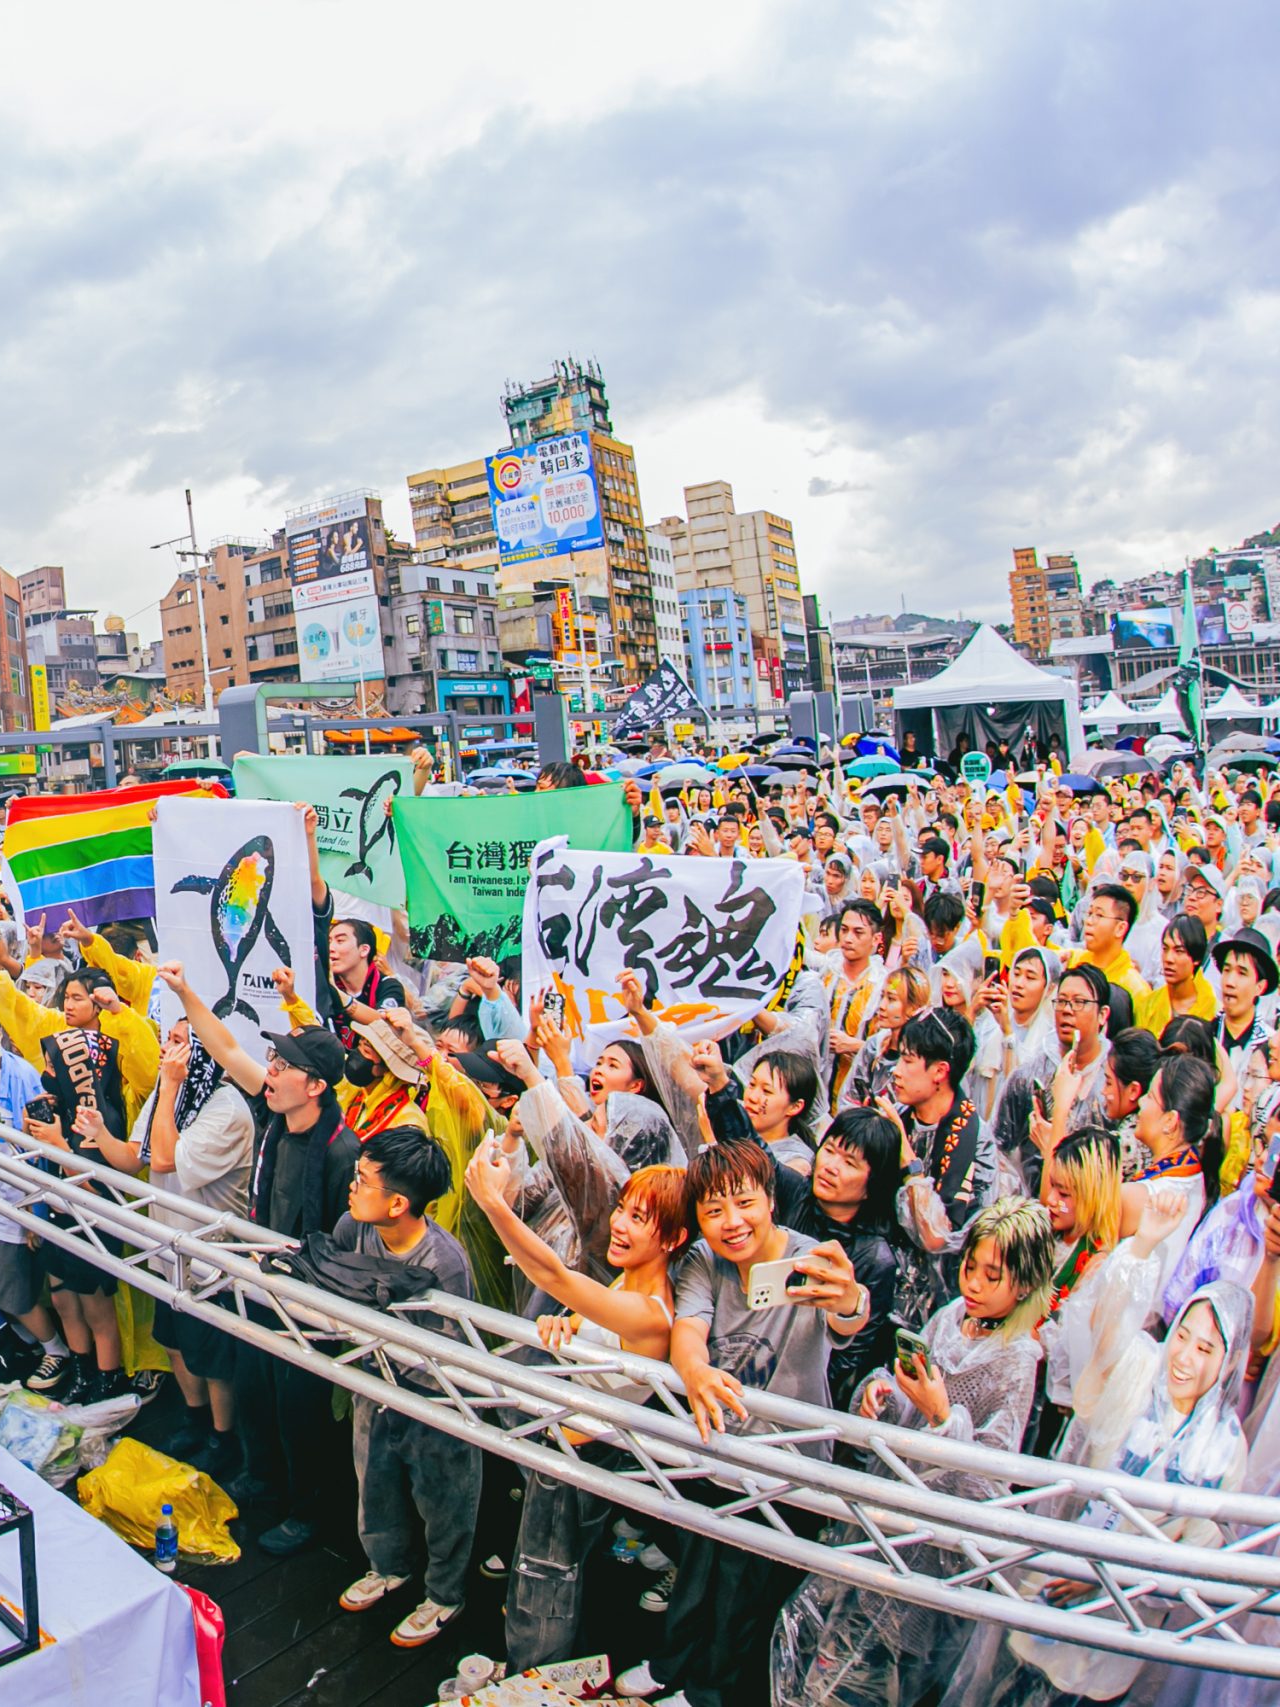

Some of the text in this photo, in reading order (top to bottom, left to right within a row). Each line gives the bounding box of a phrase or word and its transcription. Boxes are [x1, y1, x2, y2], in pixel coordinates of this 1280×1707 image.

[538, 437, 582, 458] 電動機車
[540, 452, 585, 476] 騎回家
[317, 834, 350, 846] stand for
[449, 874, 452, 883] I
[453, 876, 466, 884] am
[516, 875, 520, 884] I
[472, 887, 525, 897] Taiwan Inde
[242, 973, 276, 990] TAIW
